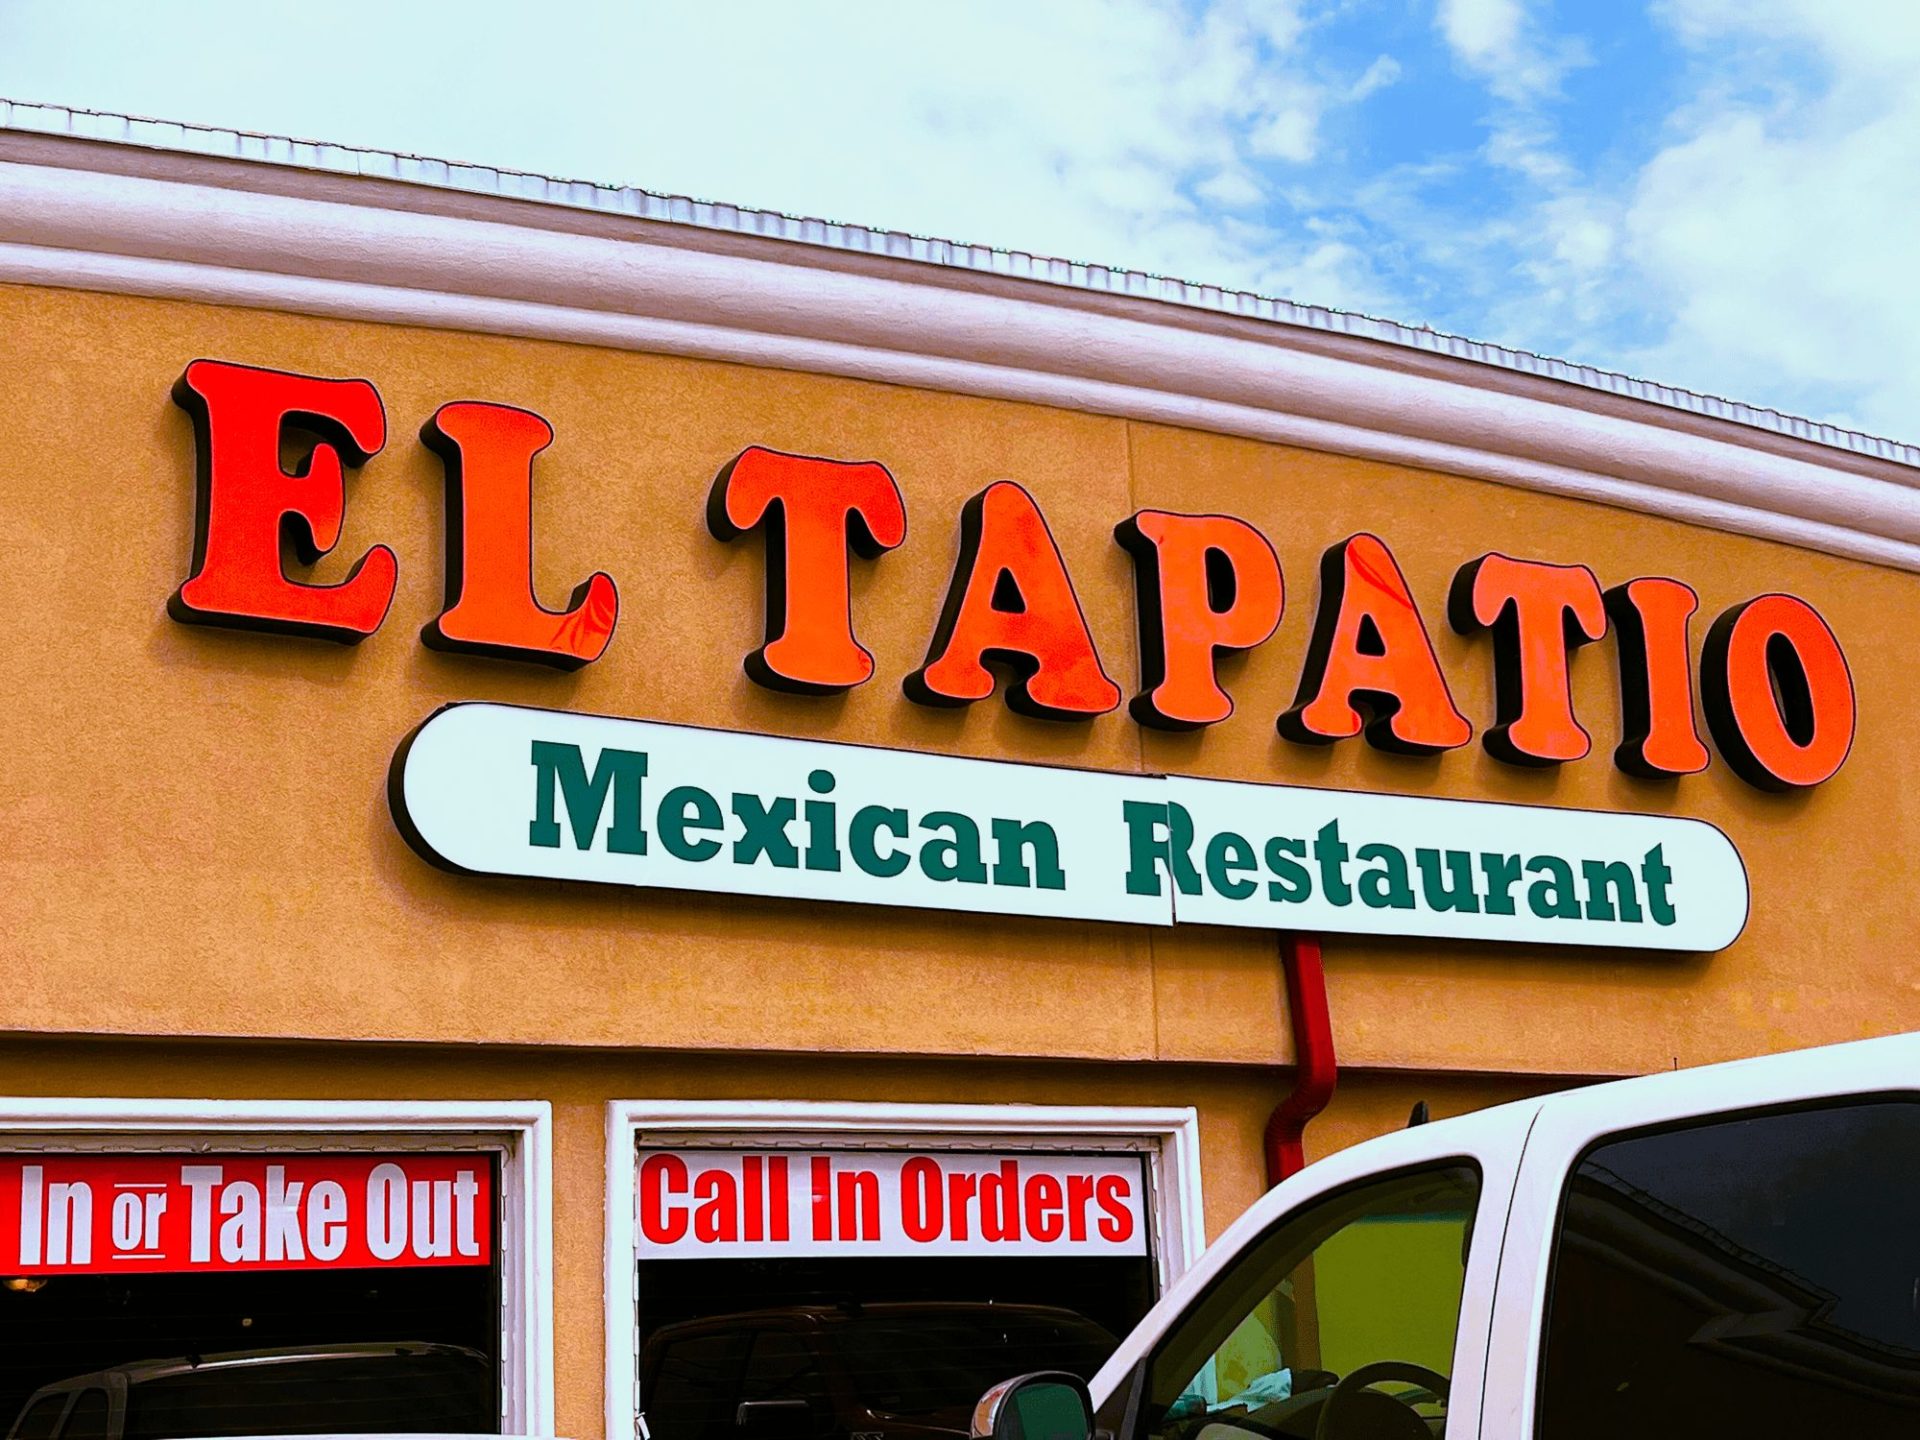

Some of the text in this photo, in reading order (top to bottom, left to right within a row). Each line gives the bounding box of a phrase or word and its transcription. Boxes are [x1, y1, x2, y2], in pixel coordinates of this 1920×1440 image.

[176, 360, 1856, 786] EL TAPATIO
[530, 740, 1677, 926] Mexican Restaurant
[19, 1162, 480, 1265] In or Take Out
[640, 1153, 1134, 1244] Call In Orders
